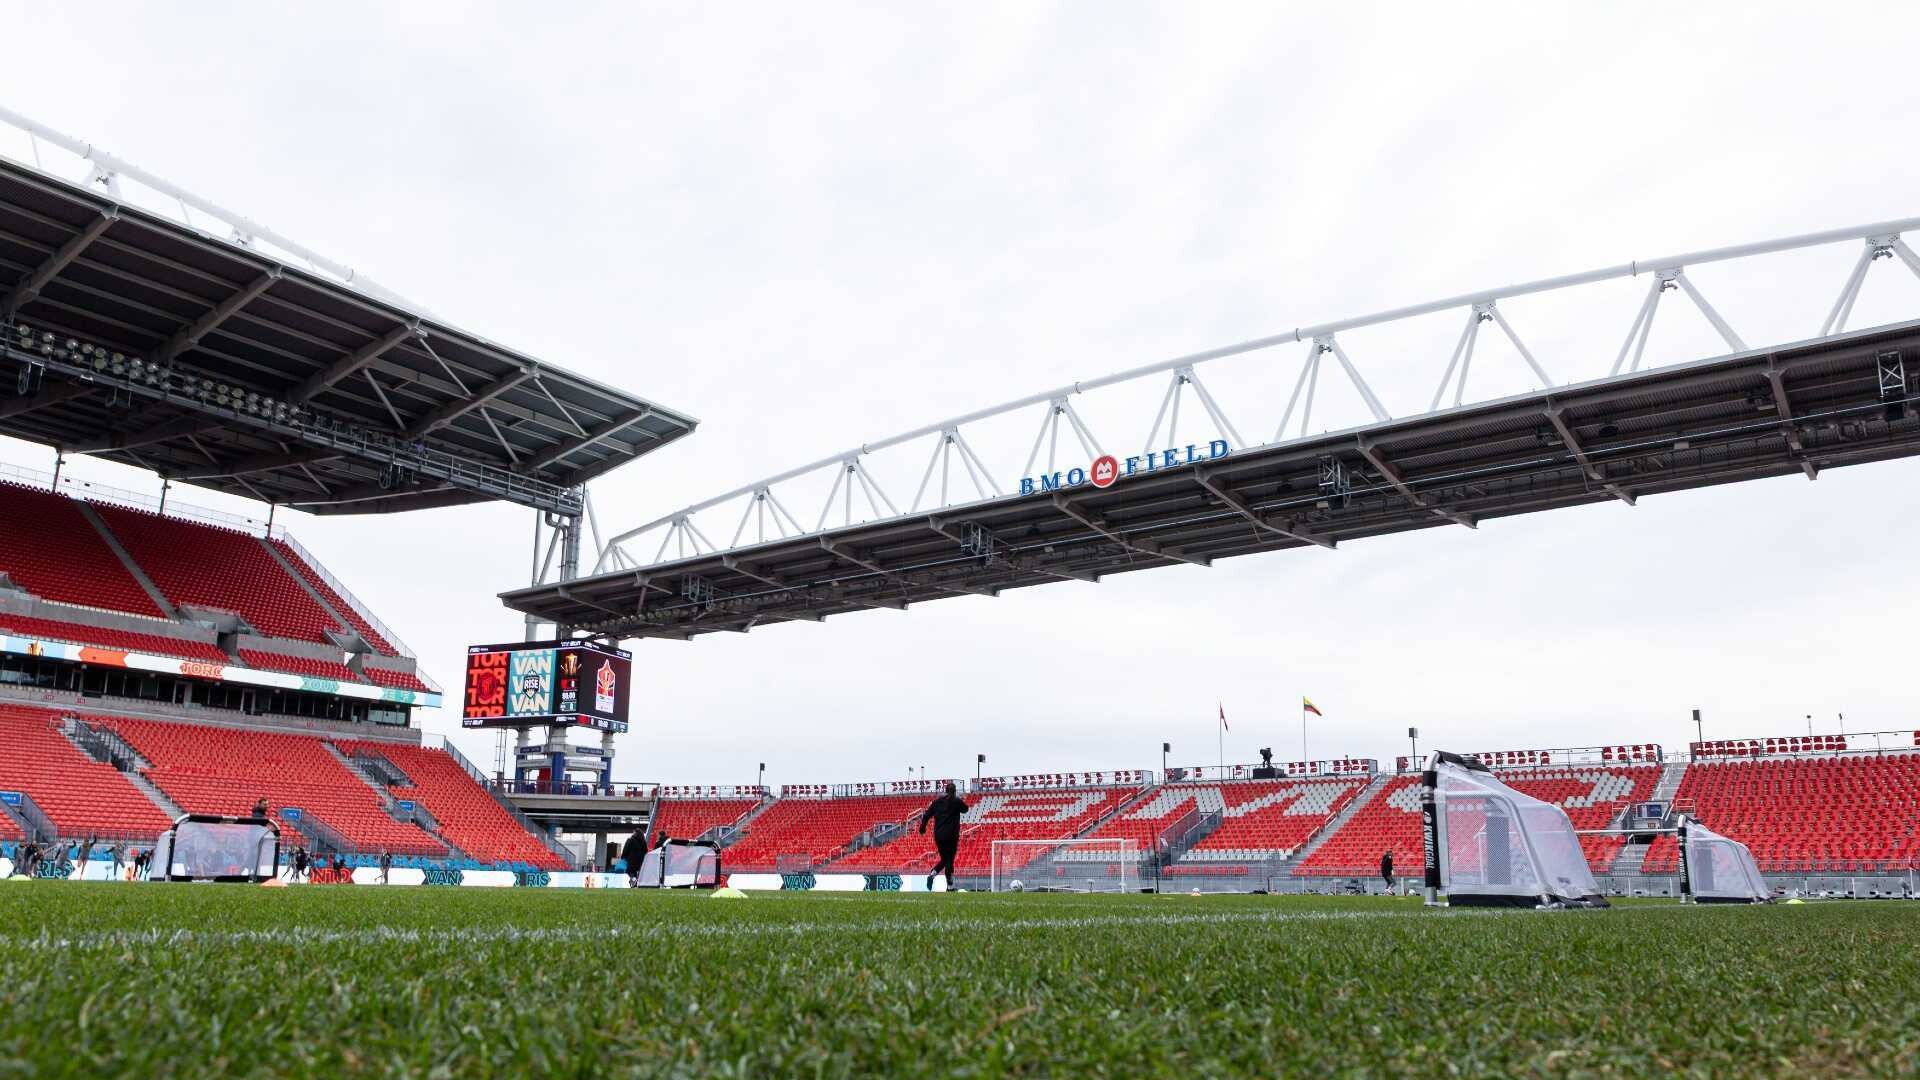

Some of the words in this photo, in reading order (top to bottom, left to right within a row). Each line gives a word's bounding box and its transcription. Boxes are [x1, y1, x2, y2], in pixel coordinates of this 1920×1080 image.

[1020, 467, 1086, 496] BMO
[1125, 439, 1229, 476] FIELD
[513, 655, 552, 675] VAN
[512, 674, 551, 694] VN
[524, 679, 539, 689] RISE
[511, 693, 550, 713] VAN
[1423, 825, 1435, 869] KWIKGOAL
